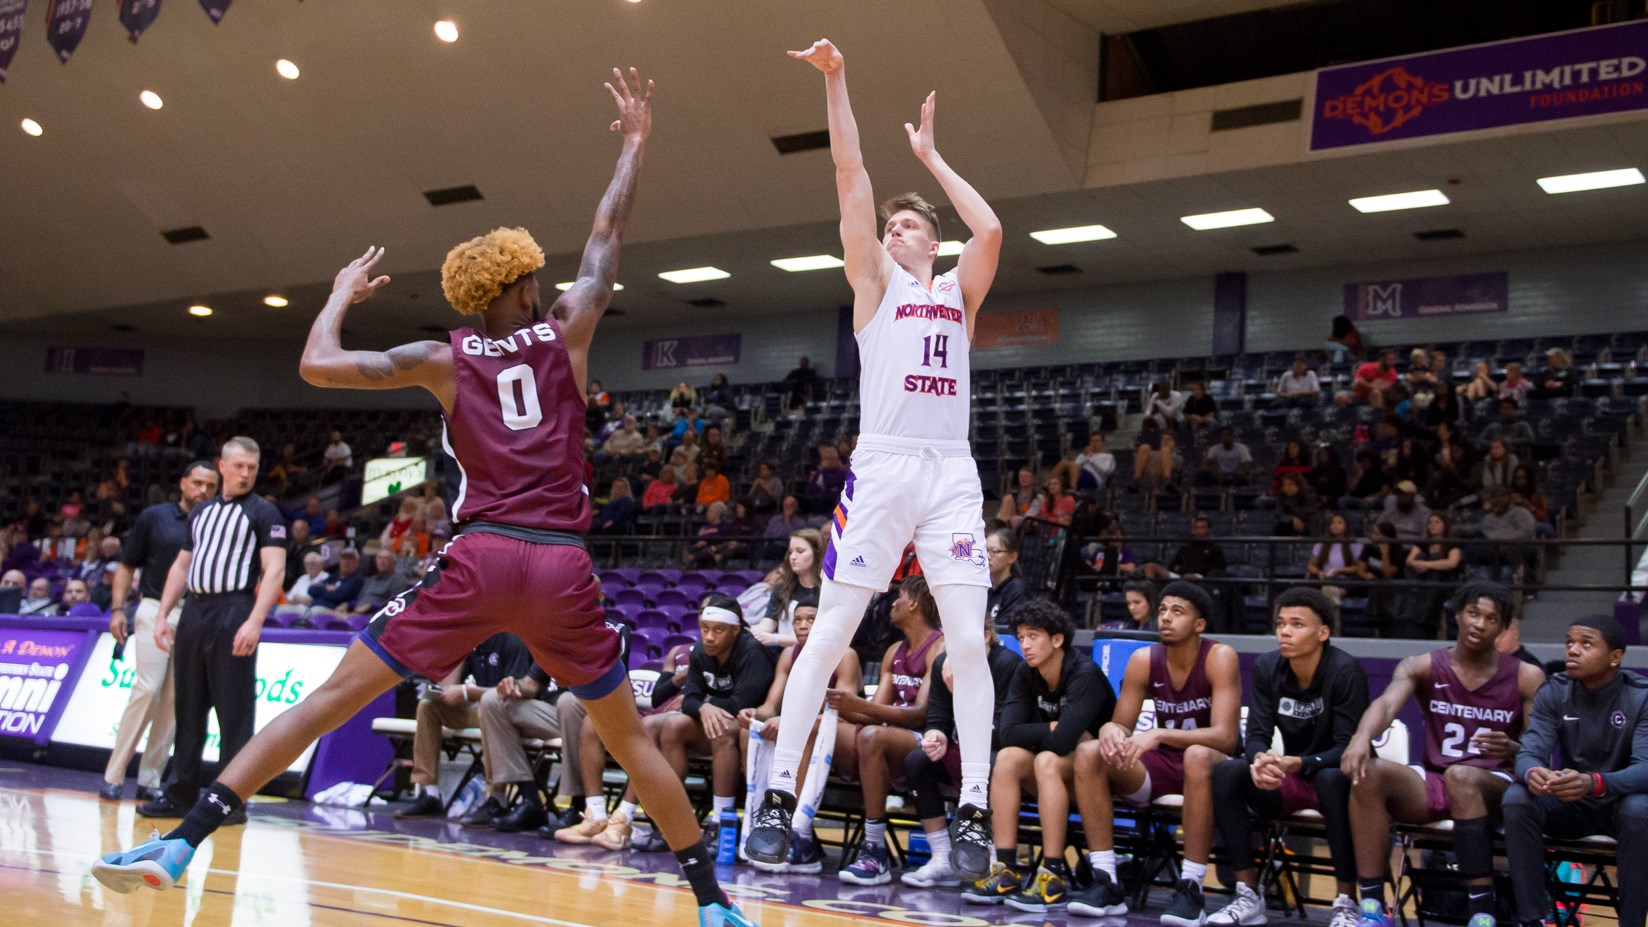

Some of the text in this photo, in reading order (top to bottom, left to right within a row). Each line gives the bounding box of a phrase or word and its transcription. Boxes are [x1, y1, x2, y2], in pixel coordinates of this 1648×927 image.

[1323, 56, 1646, 118] DEMONS UNLIMITED
[1530, 81, 1645, 109] FOUNDATION
[1367, 283, 1402, 317] M
[462, 323, 556, 357] GENTS
[656, 340, 678, 367] K
[921, 334, 949, 368] 14
[497, 364, 543, 431] 0
[904, 374, 957, 397] STATE
[958, 543, 971, 557] N
[1430, 700, 1514, 723] CENTENARY
